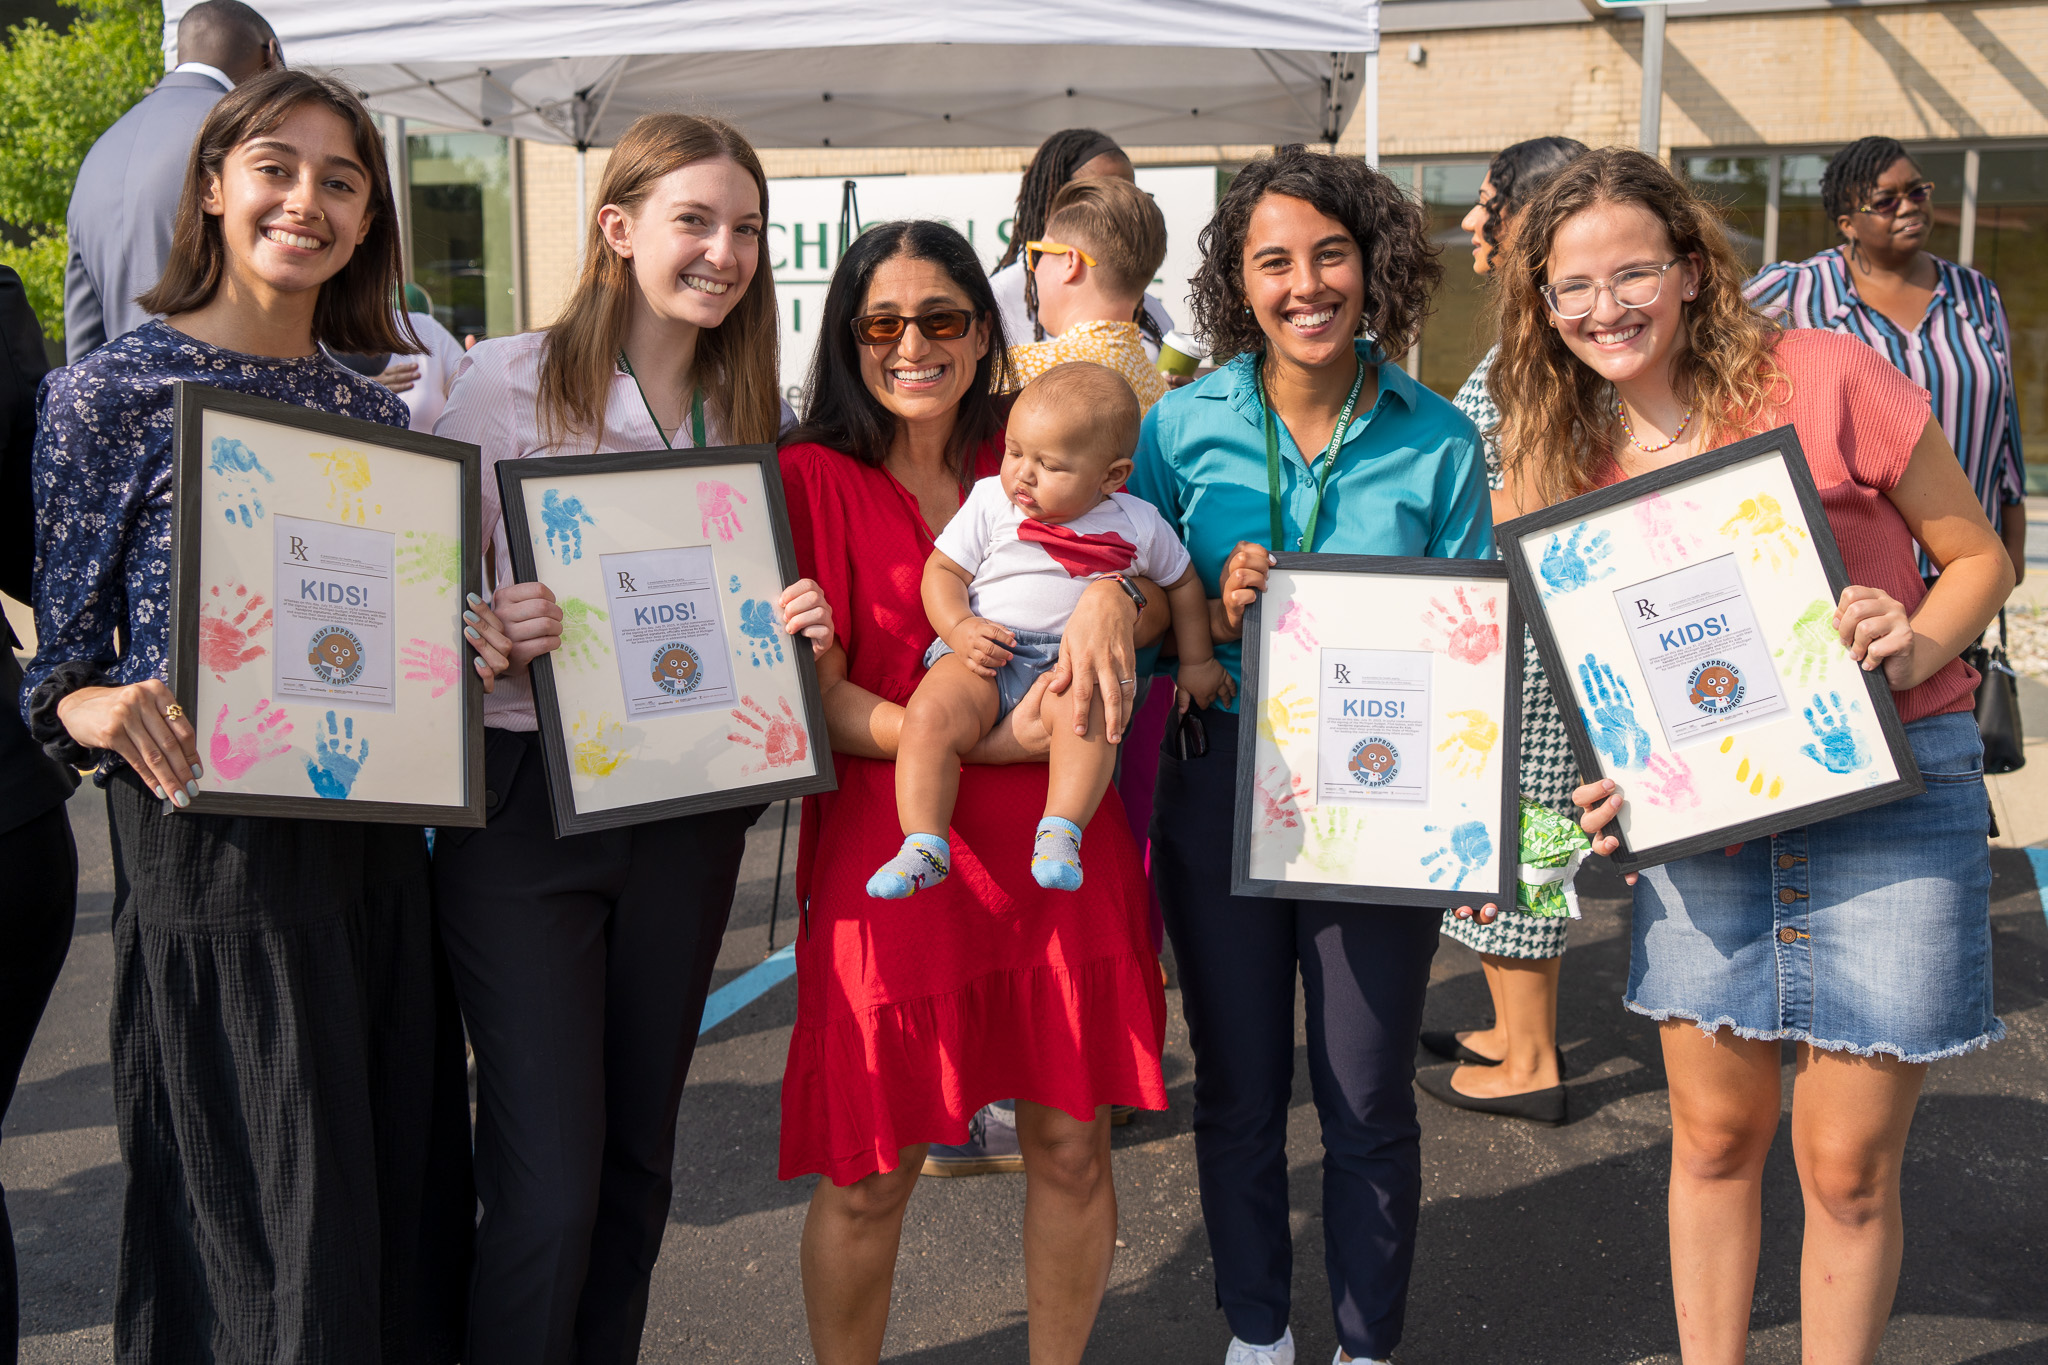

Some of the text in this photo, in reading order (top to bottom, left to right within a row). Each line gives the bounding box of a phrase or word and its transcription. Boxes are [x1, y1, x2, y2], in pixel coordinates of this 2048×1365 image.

[1340, 398, 1355, 422] STATE
[301, 579, 368, 608] KIDS!
[634, 602, 696, 626] KIDS!
[312, 626, 362, 652] BABY APPROVED
[1659, 614, 1730, 652] KIDS!
[653, 643, 699, 662] BABY APPROVED
[314, 664, 362, 684] BABY APPROVED
[659, 672, 702, 695] BABY APPROVED
[1688, 660, 1738, 684] BABY APPROVED
[1344, 698, 1405, 718] KIDS!
[1698, 704, 1717, 714] BABY
[1720, 686, 1744, 714] APPROVED
[1352, 738, 1398, 758] BABY APPROVED
[1352, 768, 1398, 787] BABY APPROVED
